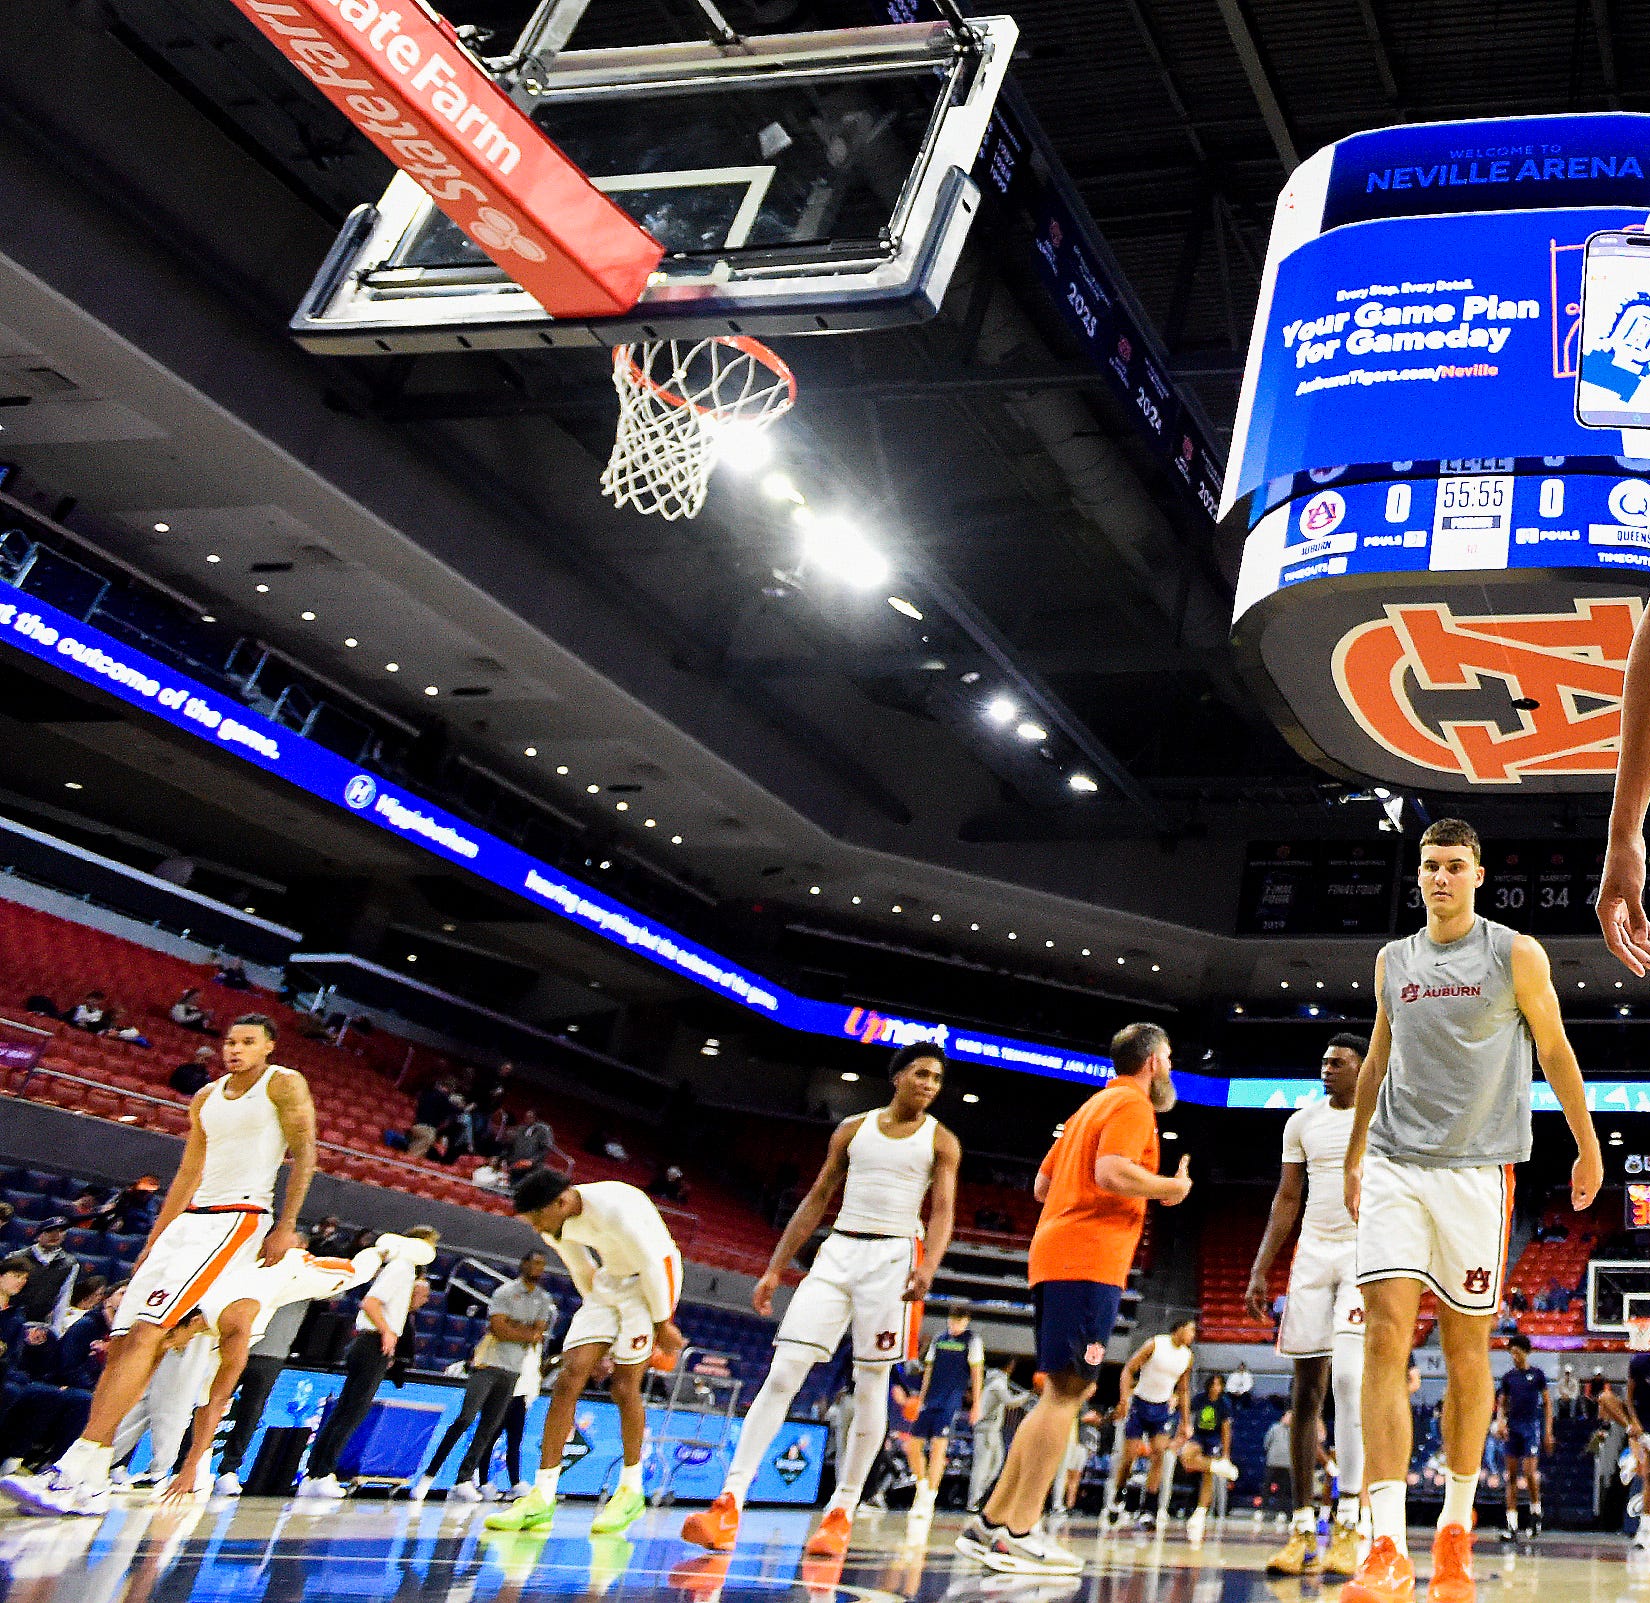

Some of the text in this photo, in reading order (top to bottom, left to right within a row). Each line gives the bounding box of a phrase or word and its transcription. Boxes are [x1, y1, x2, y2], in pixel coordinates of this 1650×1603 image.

[1450, 144, 1562, 160] WELCOME TO
[1366, 156, 1644, 193] NEVILLE ARENA
[1282, 295, 1540, 348] Your Game Plan
[1295, 323, 1511, 368] for Gameday
[1443, 480, 1504, 508] 55:55
[1539, 530, 1580, 541] FOULS
[14, 614, 59, 647] the
[57, 636, 162, 697] outcome
[158, 686, 189, 710] of
[183, 696, 223, 728] the
[217, 717, 281, 760] game.
[1496, 887, 1525, 909] 30
[1540, 887, 1569, 908] 34
[1423, 986, 1481, 998] AUBURN
